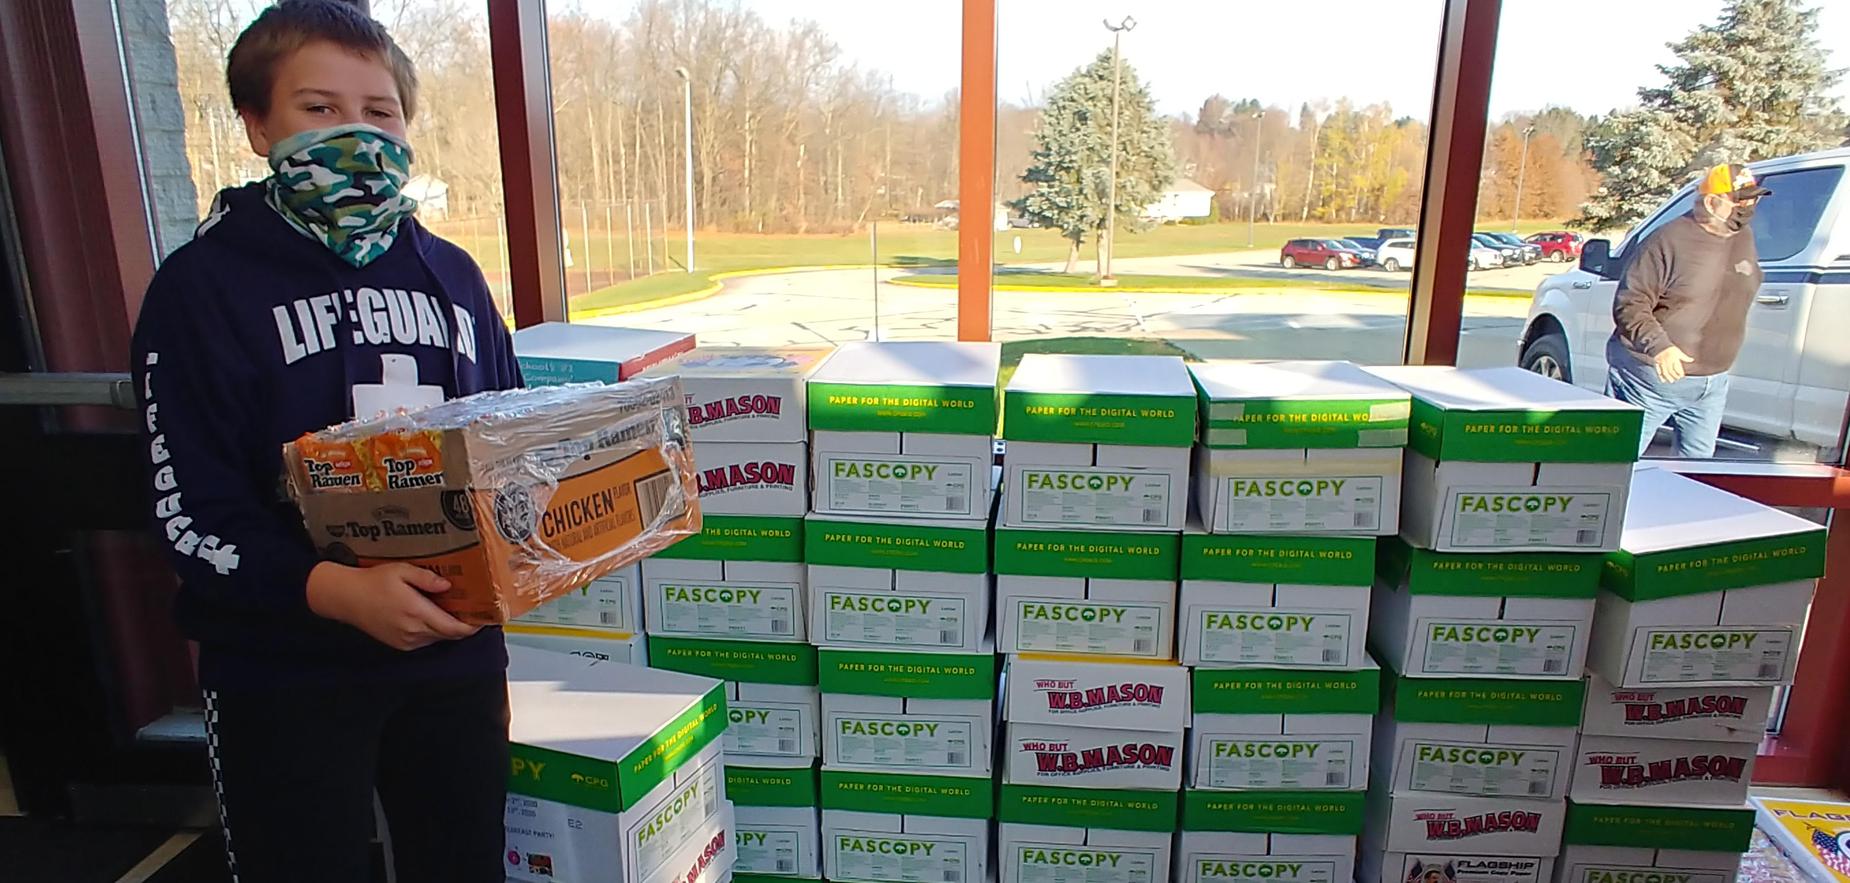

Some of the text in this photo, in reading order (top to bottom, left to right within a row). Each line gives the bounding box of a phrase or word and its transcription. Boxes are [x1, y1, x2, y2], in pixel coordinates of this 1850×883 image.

[830, 396, 857, 404] PAPER
[862, 397, 879, 405] FOR
[884, 398, 898, 406] THE
[903, 398, 938, 407] DIGITAL
[1058, 407, 1076, 415] FOR
[1141, 410, 1175, 418] WORLD
[1267, 414, 1285, 422] FOR
[1289, 414, 1307, 422] THE
[1311, 414, 1348, 422] DIGITAL
[1465, 425, 1619, 433] PAPER FOR THE DIGITAL WORLD
[384, 458, 415, 475] Top
[834, 462, 938, 480] FASCOPY
[1027, 474, 1135, 491] FASCOPY
[1234, 480, 1345, 496] FASCOPY
[453, 494, 468, 513] 48
[1461, 496, 1574, 513] FASCOPY
[542, 488, 614, 537] CHICKEN
[348, 522, 381, 541] Top
[705, 528, 791, 537] THE DIGITAL WORLD
[825, 534, 851, 542] PAPER
[896, 538, 930, 546] DIGITAL
[934, 540, 965, 549] WORLD
[1127, 547, 1159, 555] WORLD
[1203, 548, 1232, 556] PAPER
[1279, 550, 1315, 558] DIGITAL
[1508, 563, 1543, 571] DIGITAL
[1548, 564, 1580, 572] WORLD
[1658, 546, 1807, 573] PAPER FOR THE DIGITAL WORLD
[665, 586, 761, 604] FASCOPY
[831, 595, 932, 614] FASCOPY
[1023, 605, 1127, 623] FASCOPY
[1206, 614, 1315, 632] FASCOPY
[1432, 626, 1541, 643] FASCOPY
[1651, 633, 1758, 650] FASCOPY
[733, 651, 765, 660] DIGITAL
[839, 663, 864, 671] PAPER
[907, 666, 940, 674] DIGITAL
[1530, 693, 1563, 701] WORLD
[841, 721, 939, 737] FASCOPY
[634, 755, 652, 774] PAPER
[653, 744, 665, 758] FOR
[665, 736, 677, 750] THE
[677, 719, 698, 739] DIGITAL
[699, 704, 717, 722] WORLD
[1215, 743, 1320, 758] FASCOPY
[1419, 747, 1525, 766] FASCOPY
[1589, 756, 1614, 764] WHO
[728, 777, 759, 785] DIGITAL
[905, 786, 937, 794] DIGITAL
[1091, 800, 1123, 808] DIGITAL
[638, 782, 699, 848] FASCOPY
[567, 819, 583, 829] E2
[840, 838, 936, 856] FASCOPY
[1023, 850, 1122, 868] FASCOPY
[1457, 861, 1535, 869] FLAGSHIP
[1201, 863, 1303, 878] FASCOPY
